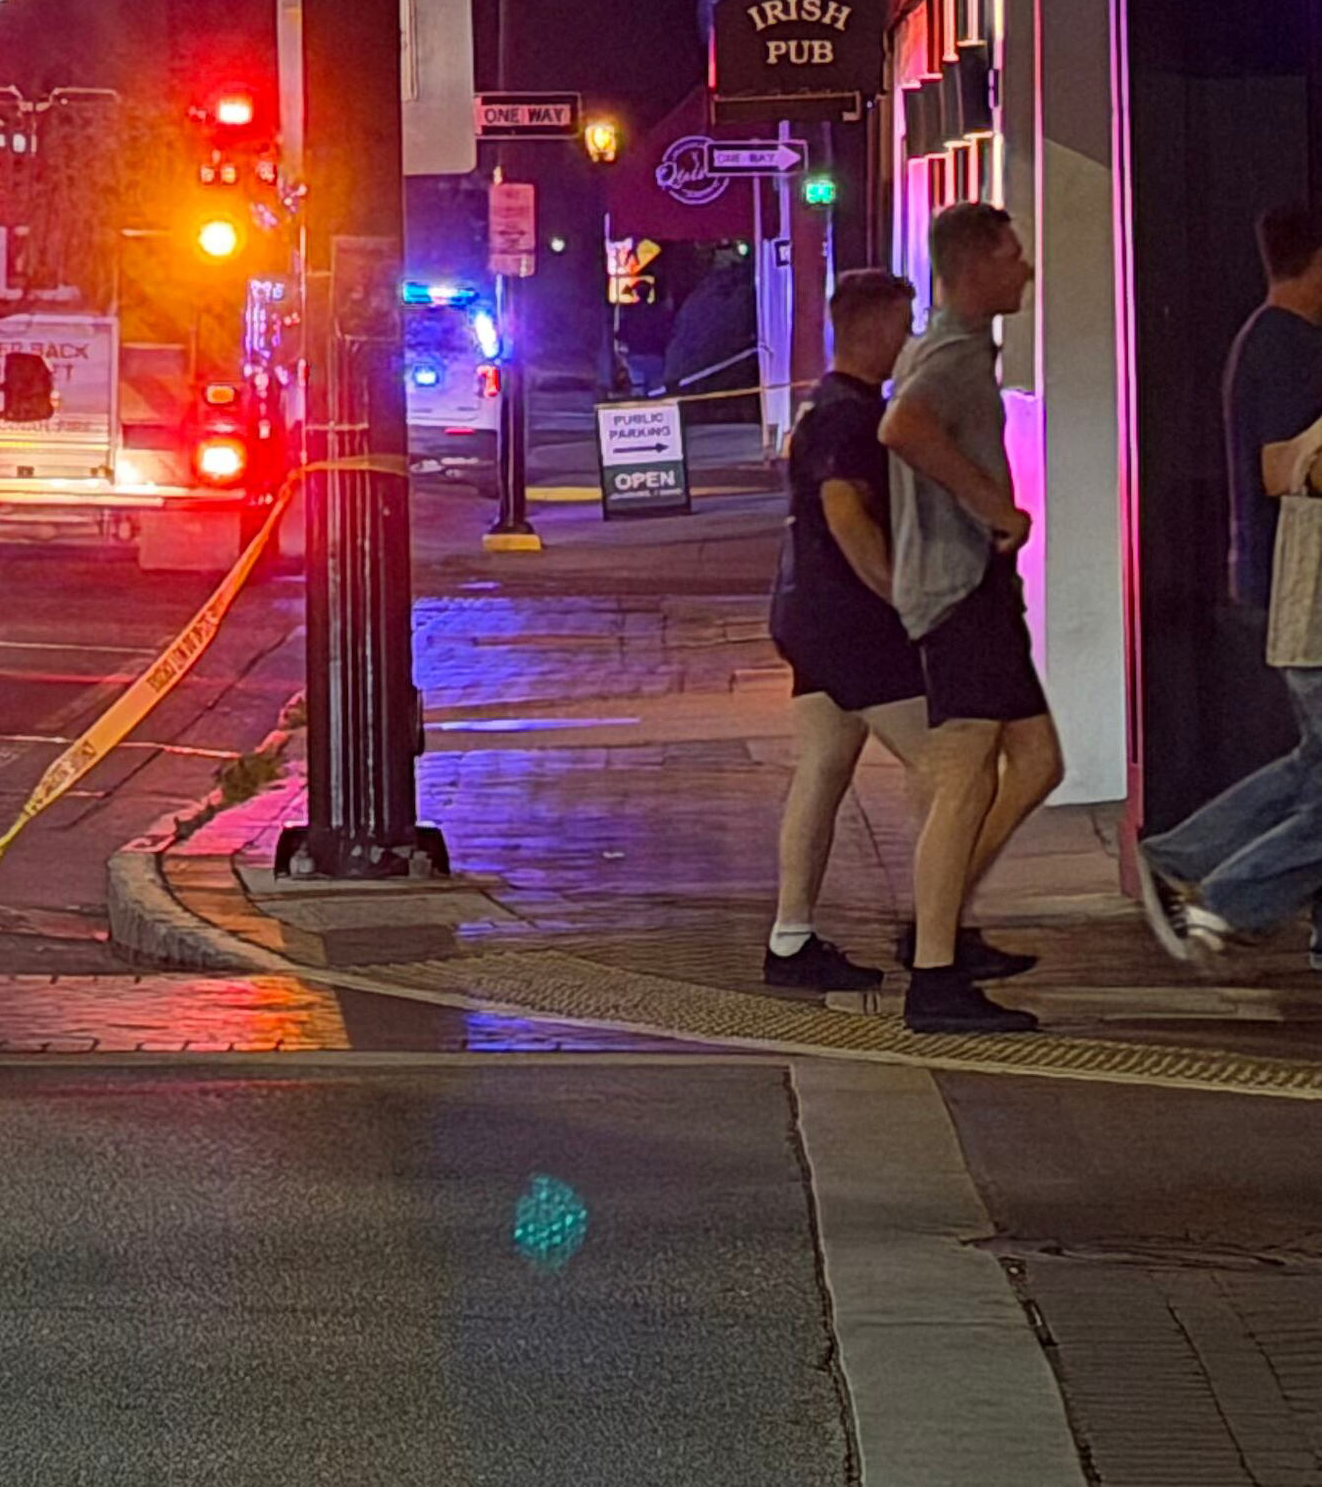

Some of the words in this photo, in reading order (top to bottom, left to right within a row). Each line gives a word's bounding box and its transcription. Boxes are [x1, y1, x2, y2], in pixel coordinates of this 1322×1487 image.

[766, 39, 834, 65] PUB
[484, 107, 520, 125] ONE
[527, 107, 565, 124] WAY
[30, 342, 90, 360] BACK
[613, 413, 664, 426] PUBLIC
[608, 425, 672, 440] PARKING
[614, 470, 676, 491] OPEN
